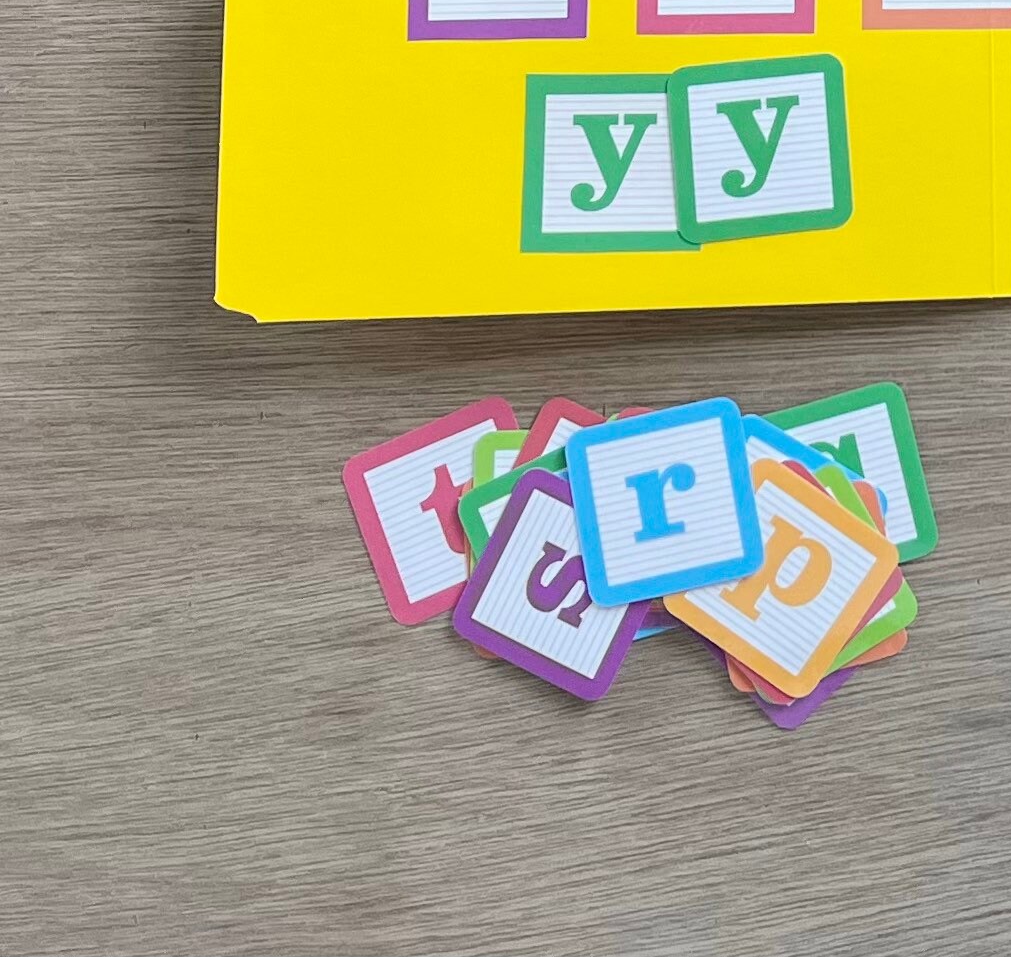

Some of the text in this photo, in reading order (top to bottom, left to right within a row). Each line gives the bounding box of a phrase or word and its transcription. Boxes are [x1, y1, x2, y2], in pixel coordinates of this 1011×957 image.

[570, 113, 657, 212] y
[717, 96, 799, 197] y
[626, 463, 696, 543] r
[527, 541, 592, 629] s
[719, 515, 832, 621] p
